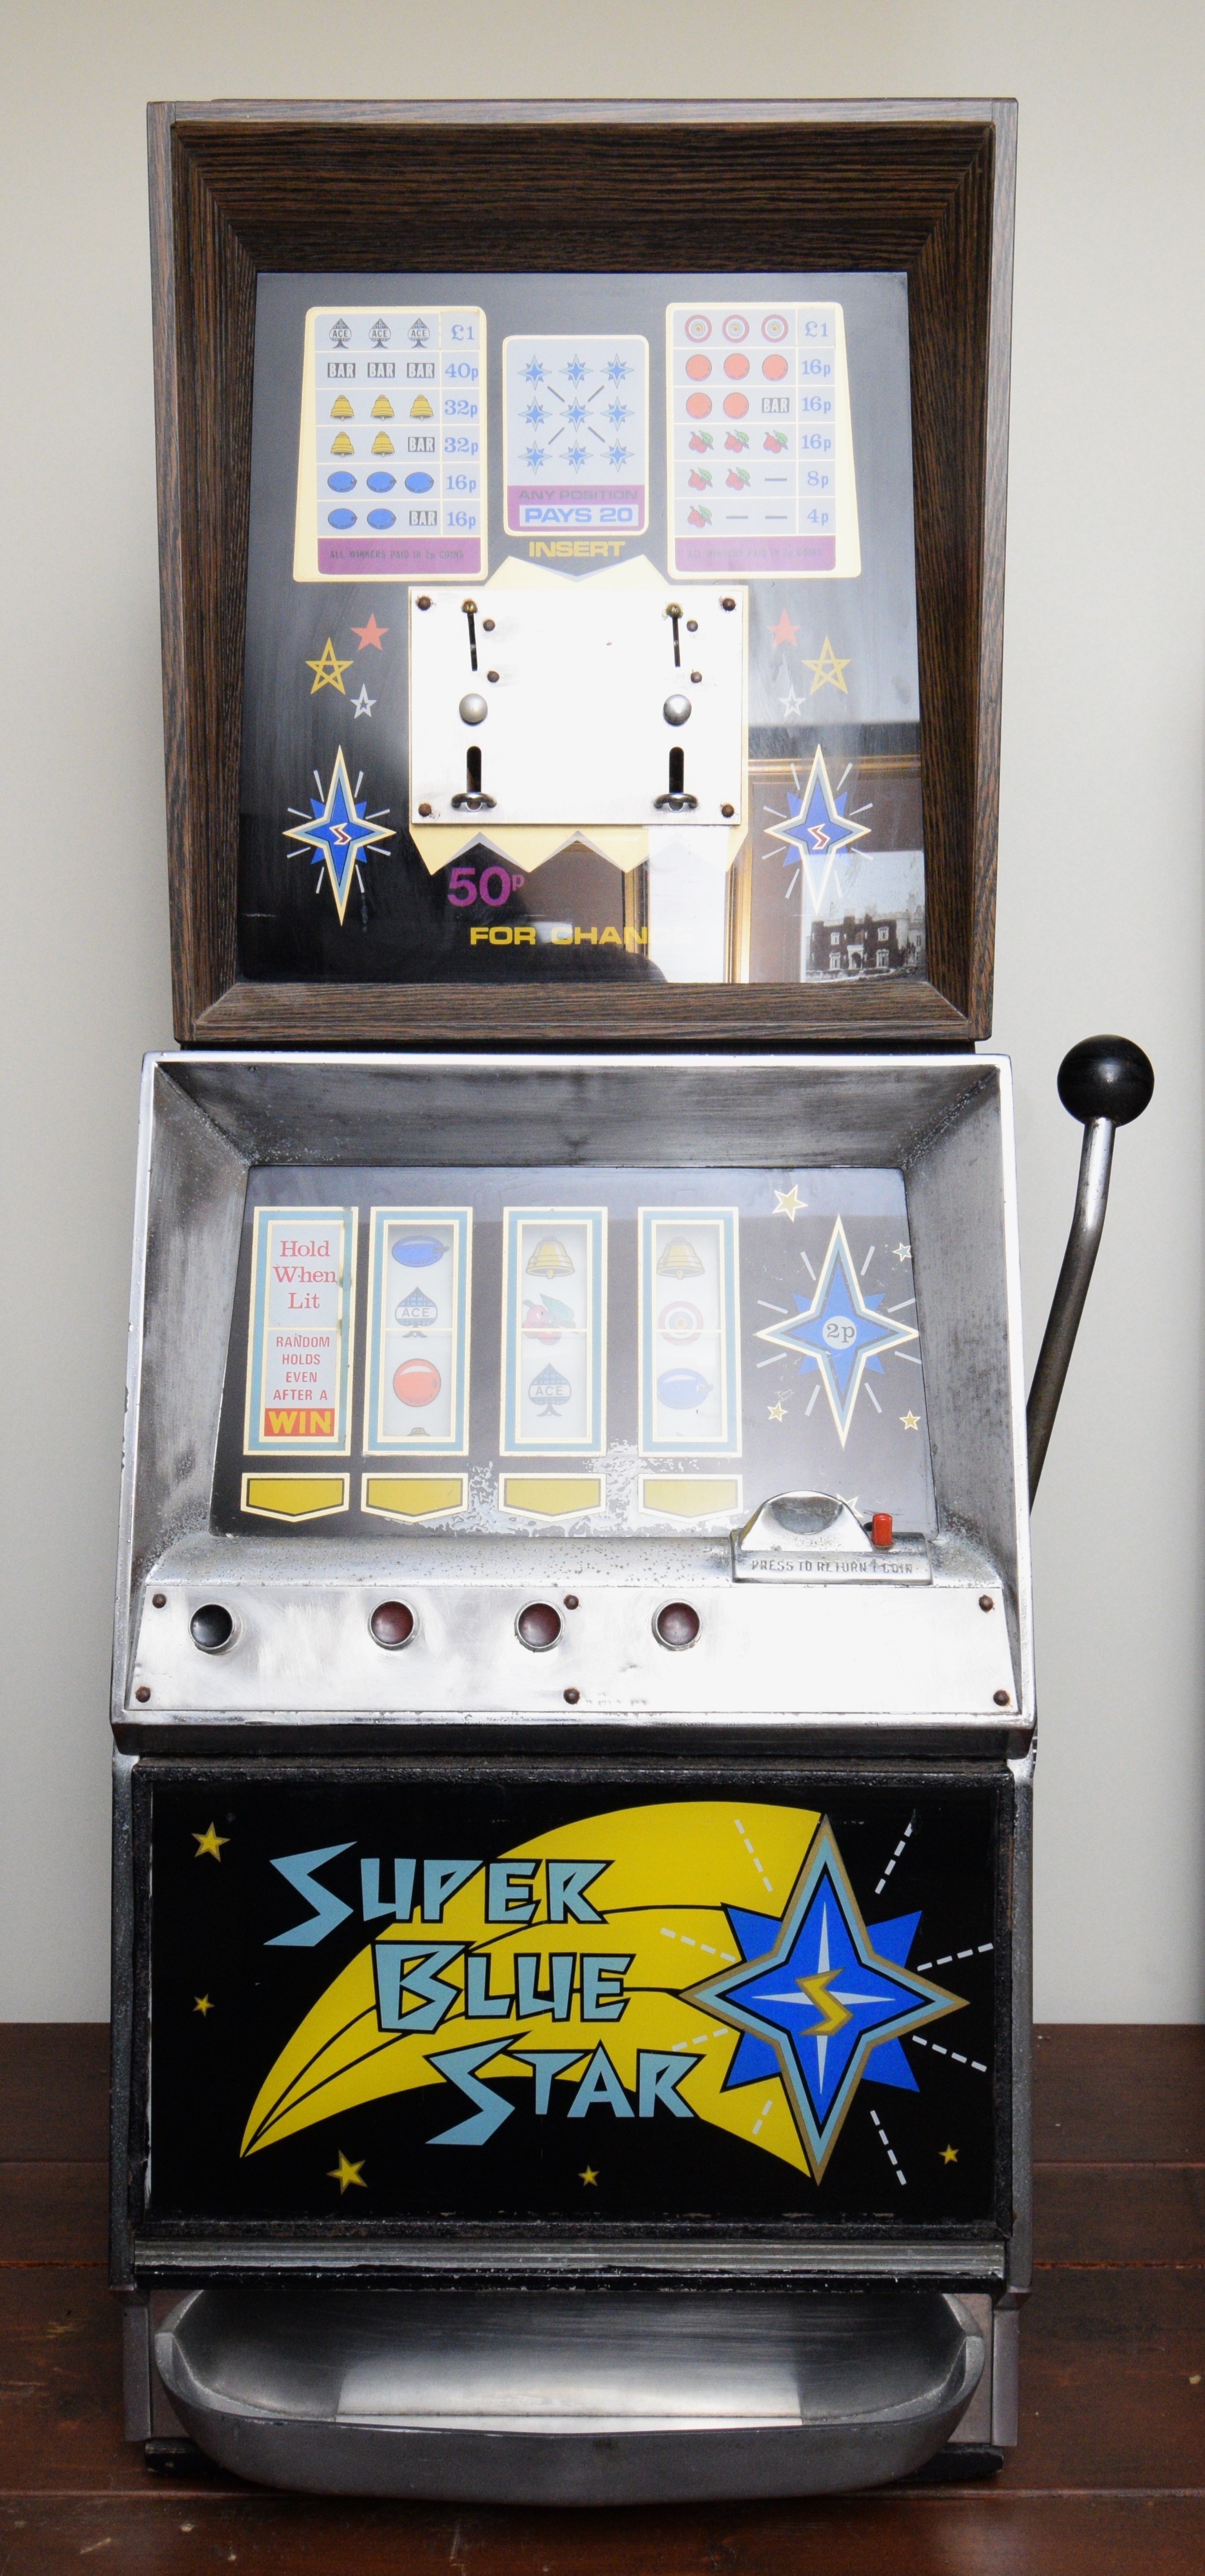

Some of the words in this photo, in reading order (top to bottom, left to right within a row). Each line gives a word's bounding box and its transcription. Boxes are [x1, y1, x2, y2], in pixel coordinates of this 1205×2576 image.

[332, 329, 348, 338] ACE
[372, 329, 388, 338] ACE
[411, 329, 428, 338] ACE
[451, 324, 474, 340] £1
[805, 321, 829, 338] £1
[329, 363, 354, 377] BAR
[369, 363, 394, 377] BAR
[408, 363, 434, 377] BAR
[445, 362, 479, 381] 40p
[801, 359, 831, 377] 16p
[444, 400, 479, 418] 32p
[763, 398, 788, 413] BAR
[801, 396, 832, 415] 16p
[409, 437, 435, 452] BAR
[444, 437, 479, 456] 32p
[801, 434, 832, 453] 16p
[446, 475, 476, 493] 16p
[807, 471, 829, 488] 8p
[518, 490, 555, 501] ANY
[559, 490, 638, 501] POSITION
[411, 511, 436, 526] BAR
[446, 512, 476, 530] 16p
[525, 508, 592, 523] PAYS
[600, 508, 633, 522] 20
[807, 509, 829, 526] 4p
[330, 550, 344, 559] ALL
[350, 550, 386, 559] WINNERS
[390, 550, 409, 559] PAID
[439, 550, 464, 559] COINS
[529, 541, 625, 557] INSERT
[447, 866, 525, 907] 50p
[470, 927, 536, 945] FOR
[280, 1241, 330, 1257] Hold
[274, 1267, 338, 1283] When
[287, 1293, 320, 1309] Lit
[401, 1307, 429, 1318] ACE
[826, 1322, 855, 1343] 2p
[276, 1337, 330, 1347] RANDOM
[282, 1354, 321, 1365] HOLDS
[285, 1372, 317, 1383] EVEN
[273, 1390, 313, 1400] AFTER
[320, 1390, 328, 1400] A
[535, 1386, 563, 1396] ACE
[268, 1411, 331, 1434] WIN
[752, 1560, 794, 1571] PRESS
[799, 1560, 813, 1571] TO
[817, 1562, 866, 1572] RETURN
[883, 1563, 913, 1573] COIN
[264, 1842, 615, 1947] SUPER
[370, 1941, 636, 2033] BLUE
[424, 2032, 704, 2147] STAR
